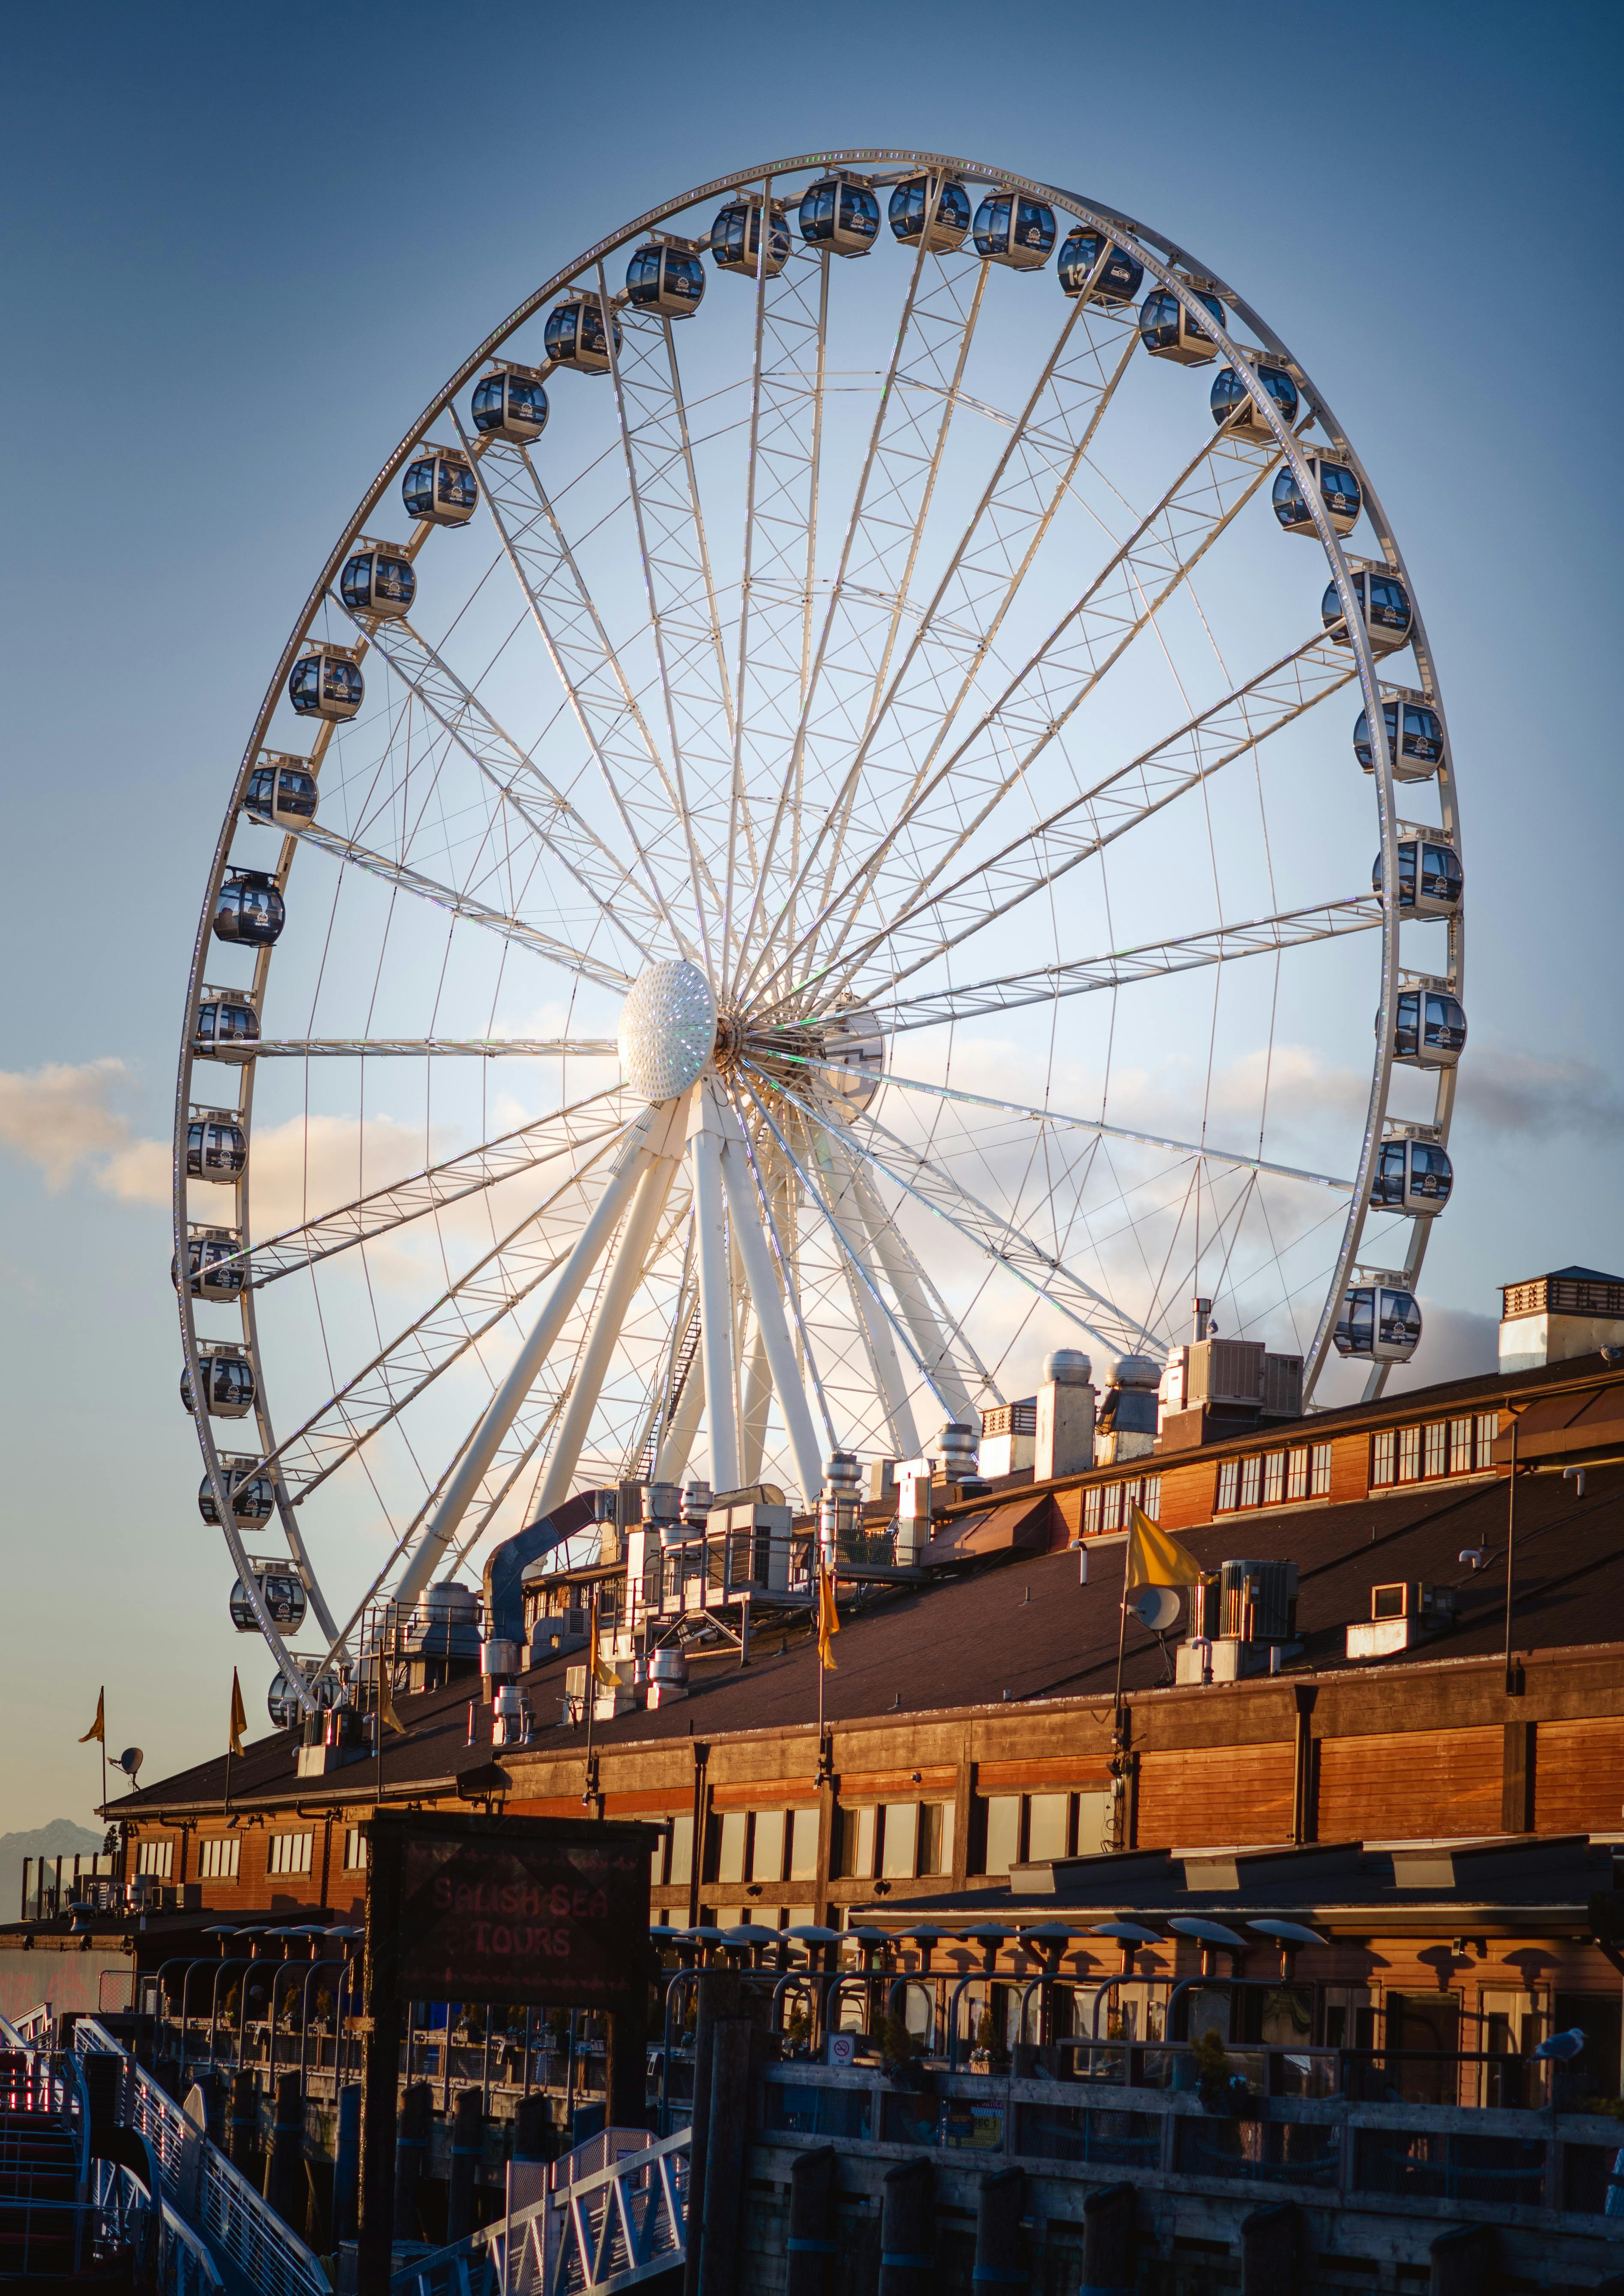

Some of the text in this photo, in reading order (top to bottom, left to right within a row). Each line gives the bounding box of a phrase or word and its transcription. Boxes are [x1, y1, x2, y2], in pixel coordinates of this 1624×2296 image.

[1067, 263, 1088, 286] 12
[433, 1877, 608, 1917] SALISH SEA
[471, 1921, 570, 1957] TOURS
